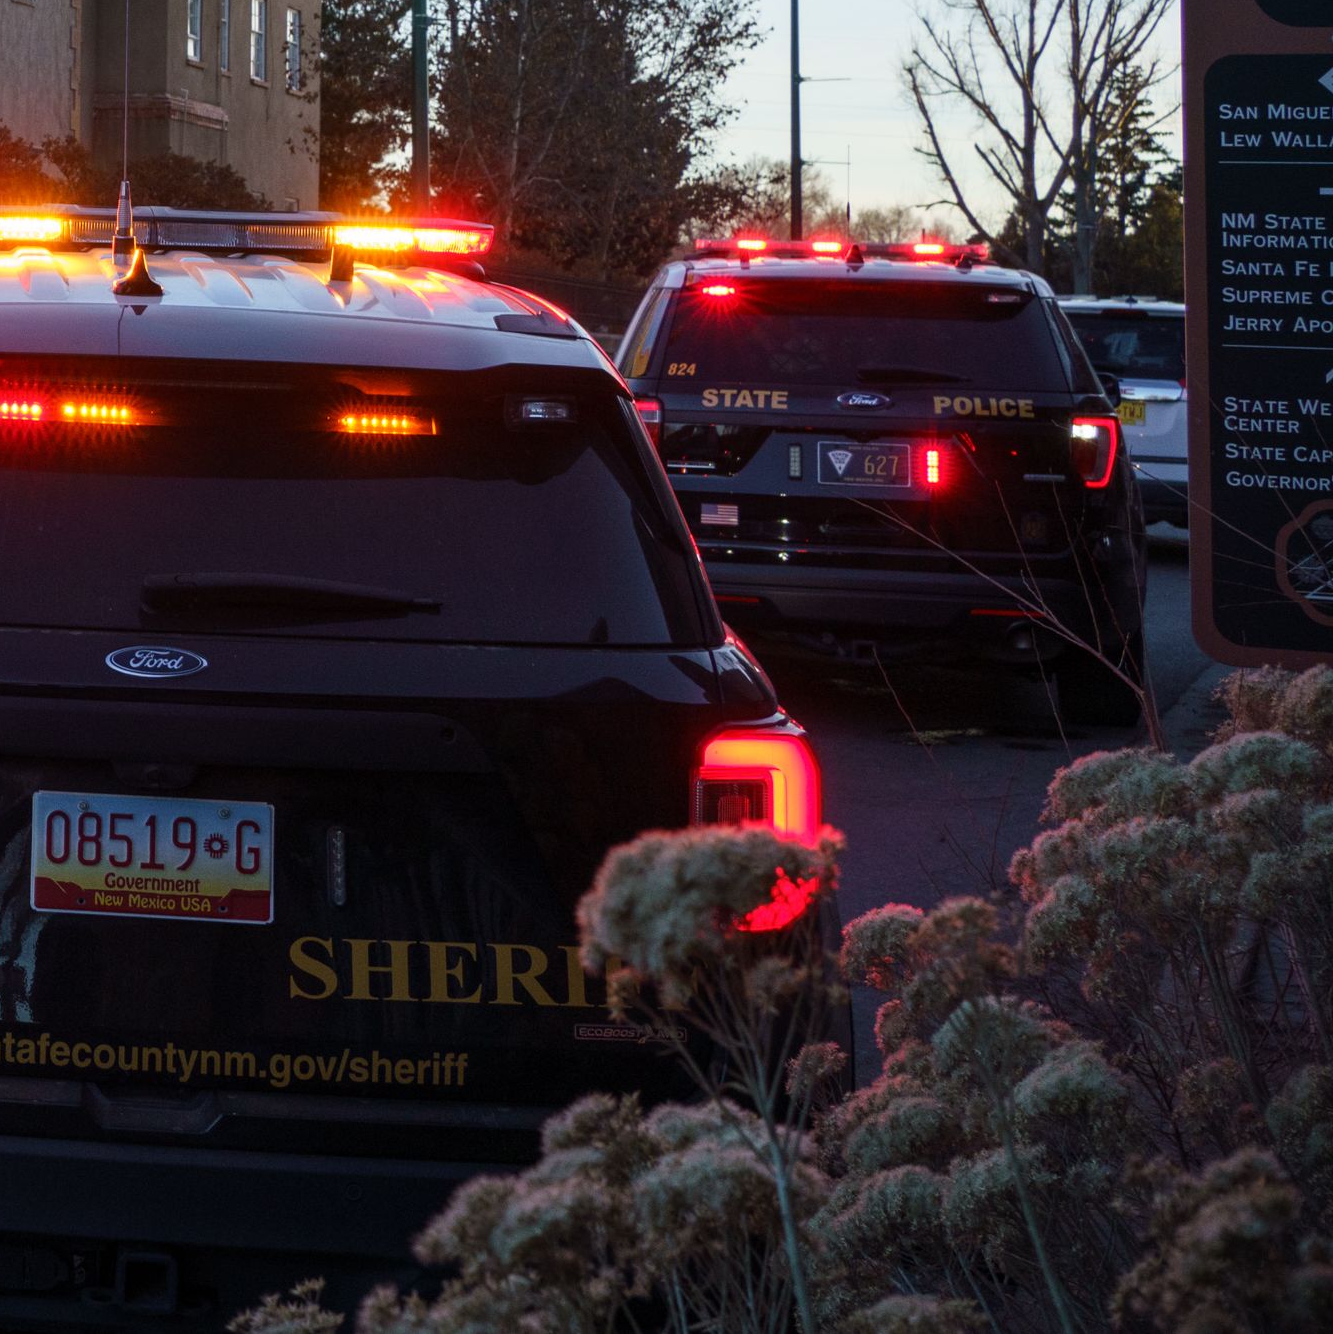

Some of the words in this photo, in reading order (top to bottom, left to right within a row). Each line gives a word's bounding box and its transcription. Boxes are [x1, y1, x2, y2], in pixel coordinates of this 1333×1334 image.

[1219, 104, 1258, 120] SAN
[1267, 104, 1333, 120] MIGUE
[1220, 131, 1262, 147] LEW
[1221, 212, 1255, 229] NM
[1264, 213, 1326, 230] STATE
[1221, 259, 1285, 276] SANTA
[1295, 260, 1321, 277] FE
[1222, 287, 1313, 304] SUPREME
[1223, 314, 1284, 332] JERRY
[667, 362, 697, 376] 824
[702, 388, 789, 409] STATE
[932, 395, 1036, 419] POLICE
[1224, 396, 1289, 414] STATE
[1297, 398, 1332, 416] WE
[1224, 415, 1300, 434] CENTER
[1225, 442, 1286, 461] STATE
[864, 455, 900, 476] 627
[45, 809, 198, 872] 08519
[104, 871, 201, 894] Government
[94, 892, 123, 907] New
[128, 893, 176, 910] Mexico
[180, 897, 212, 912] USA
[288, 935, 697, 1011] SHERI
